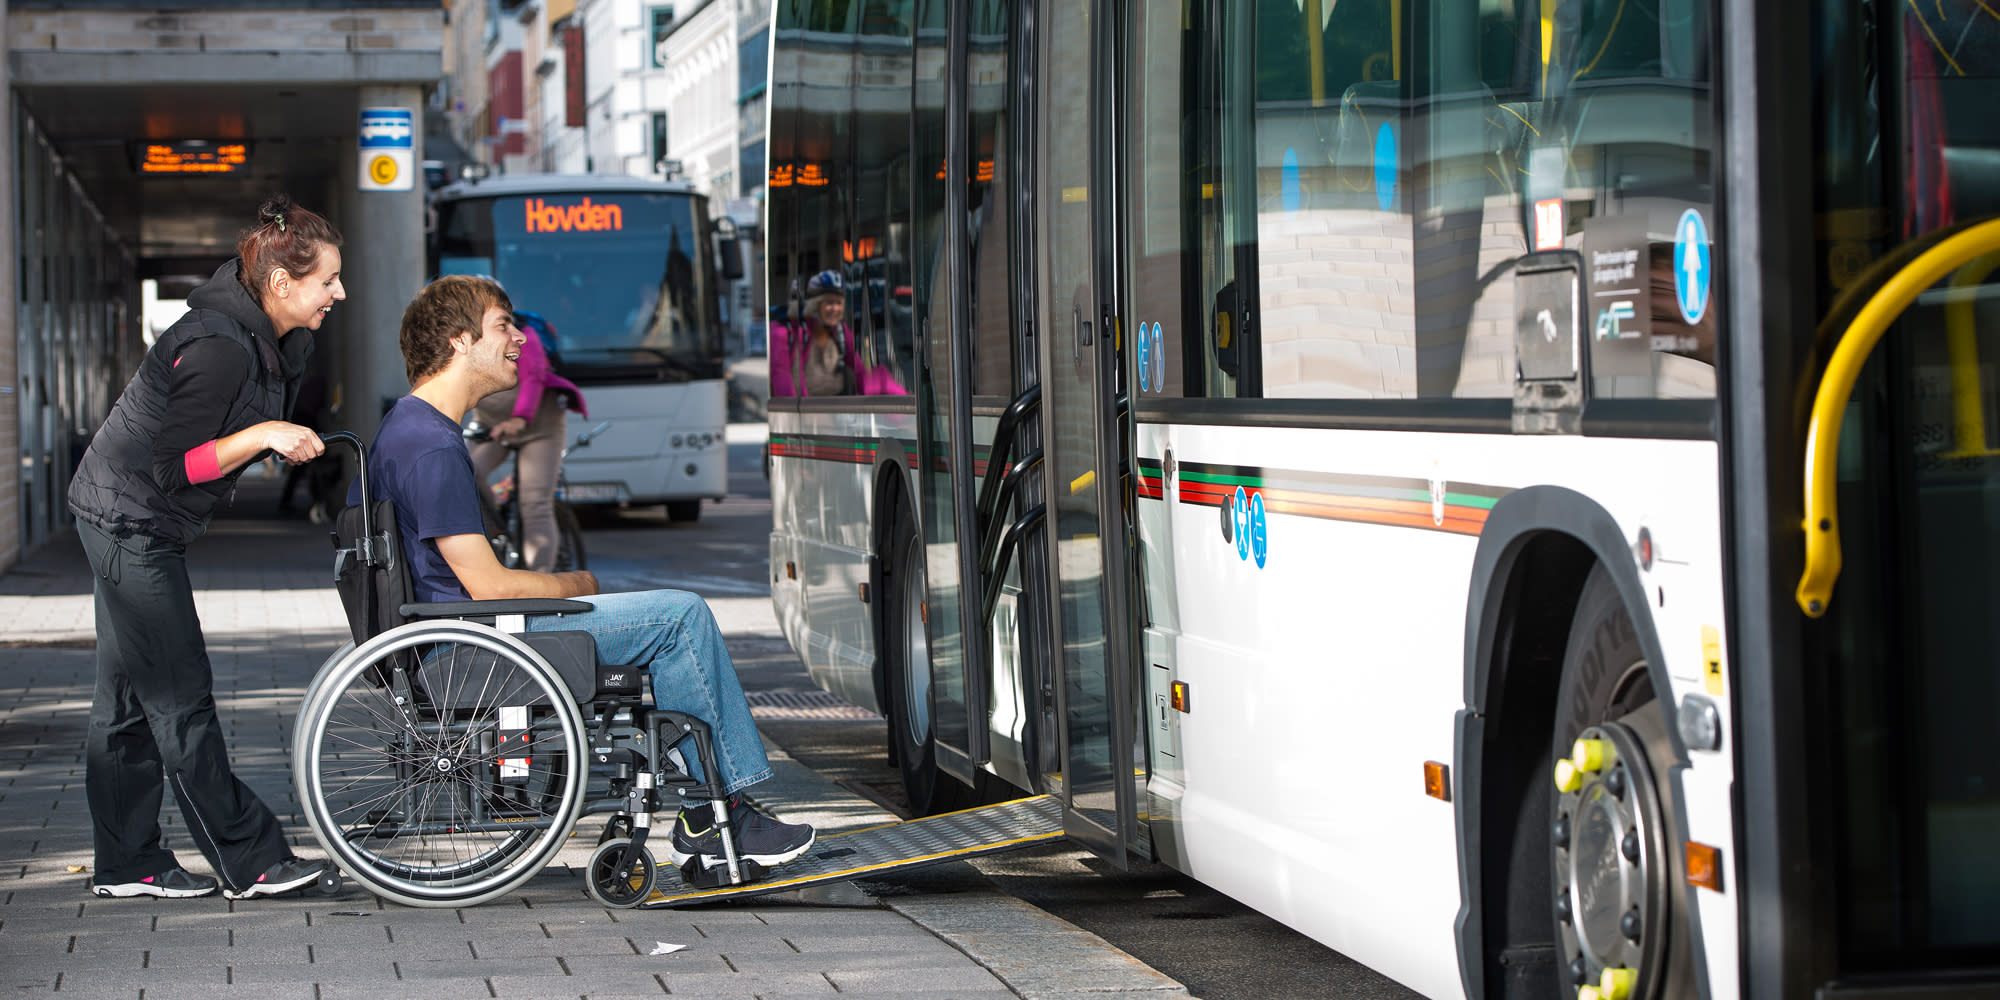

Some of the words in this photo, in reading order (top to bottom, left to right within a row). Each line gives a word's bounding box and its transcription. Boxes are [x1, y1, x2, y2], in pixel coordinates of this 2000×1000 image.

[376, 159, 390, 180] C
[525, 197, 622, 233] Hovden
[605, 679, 623, 687] Basic
